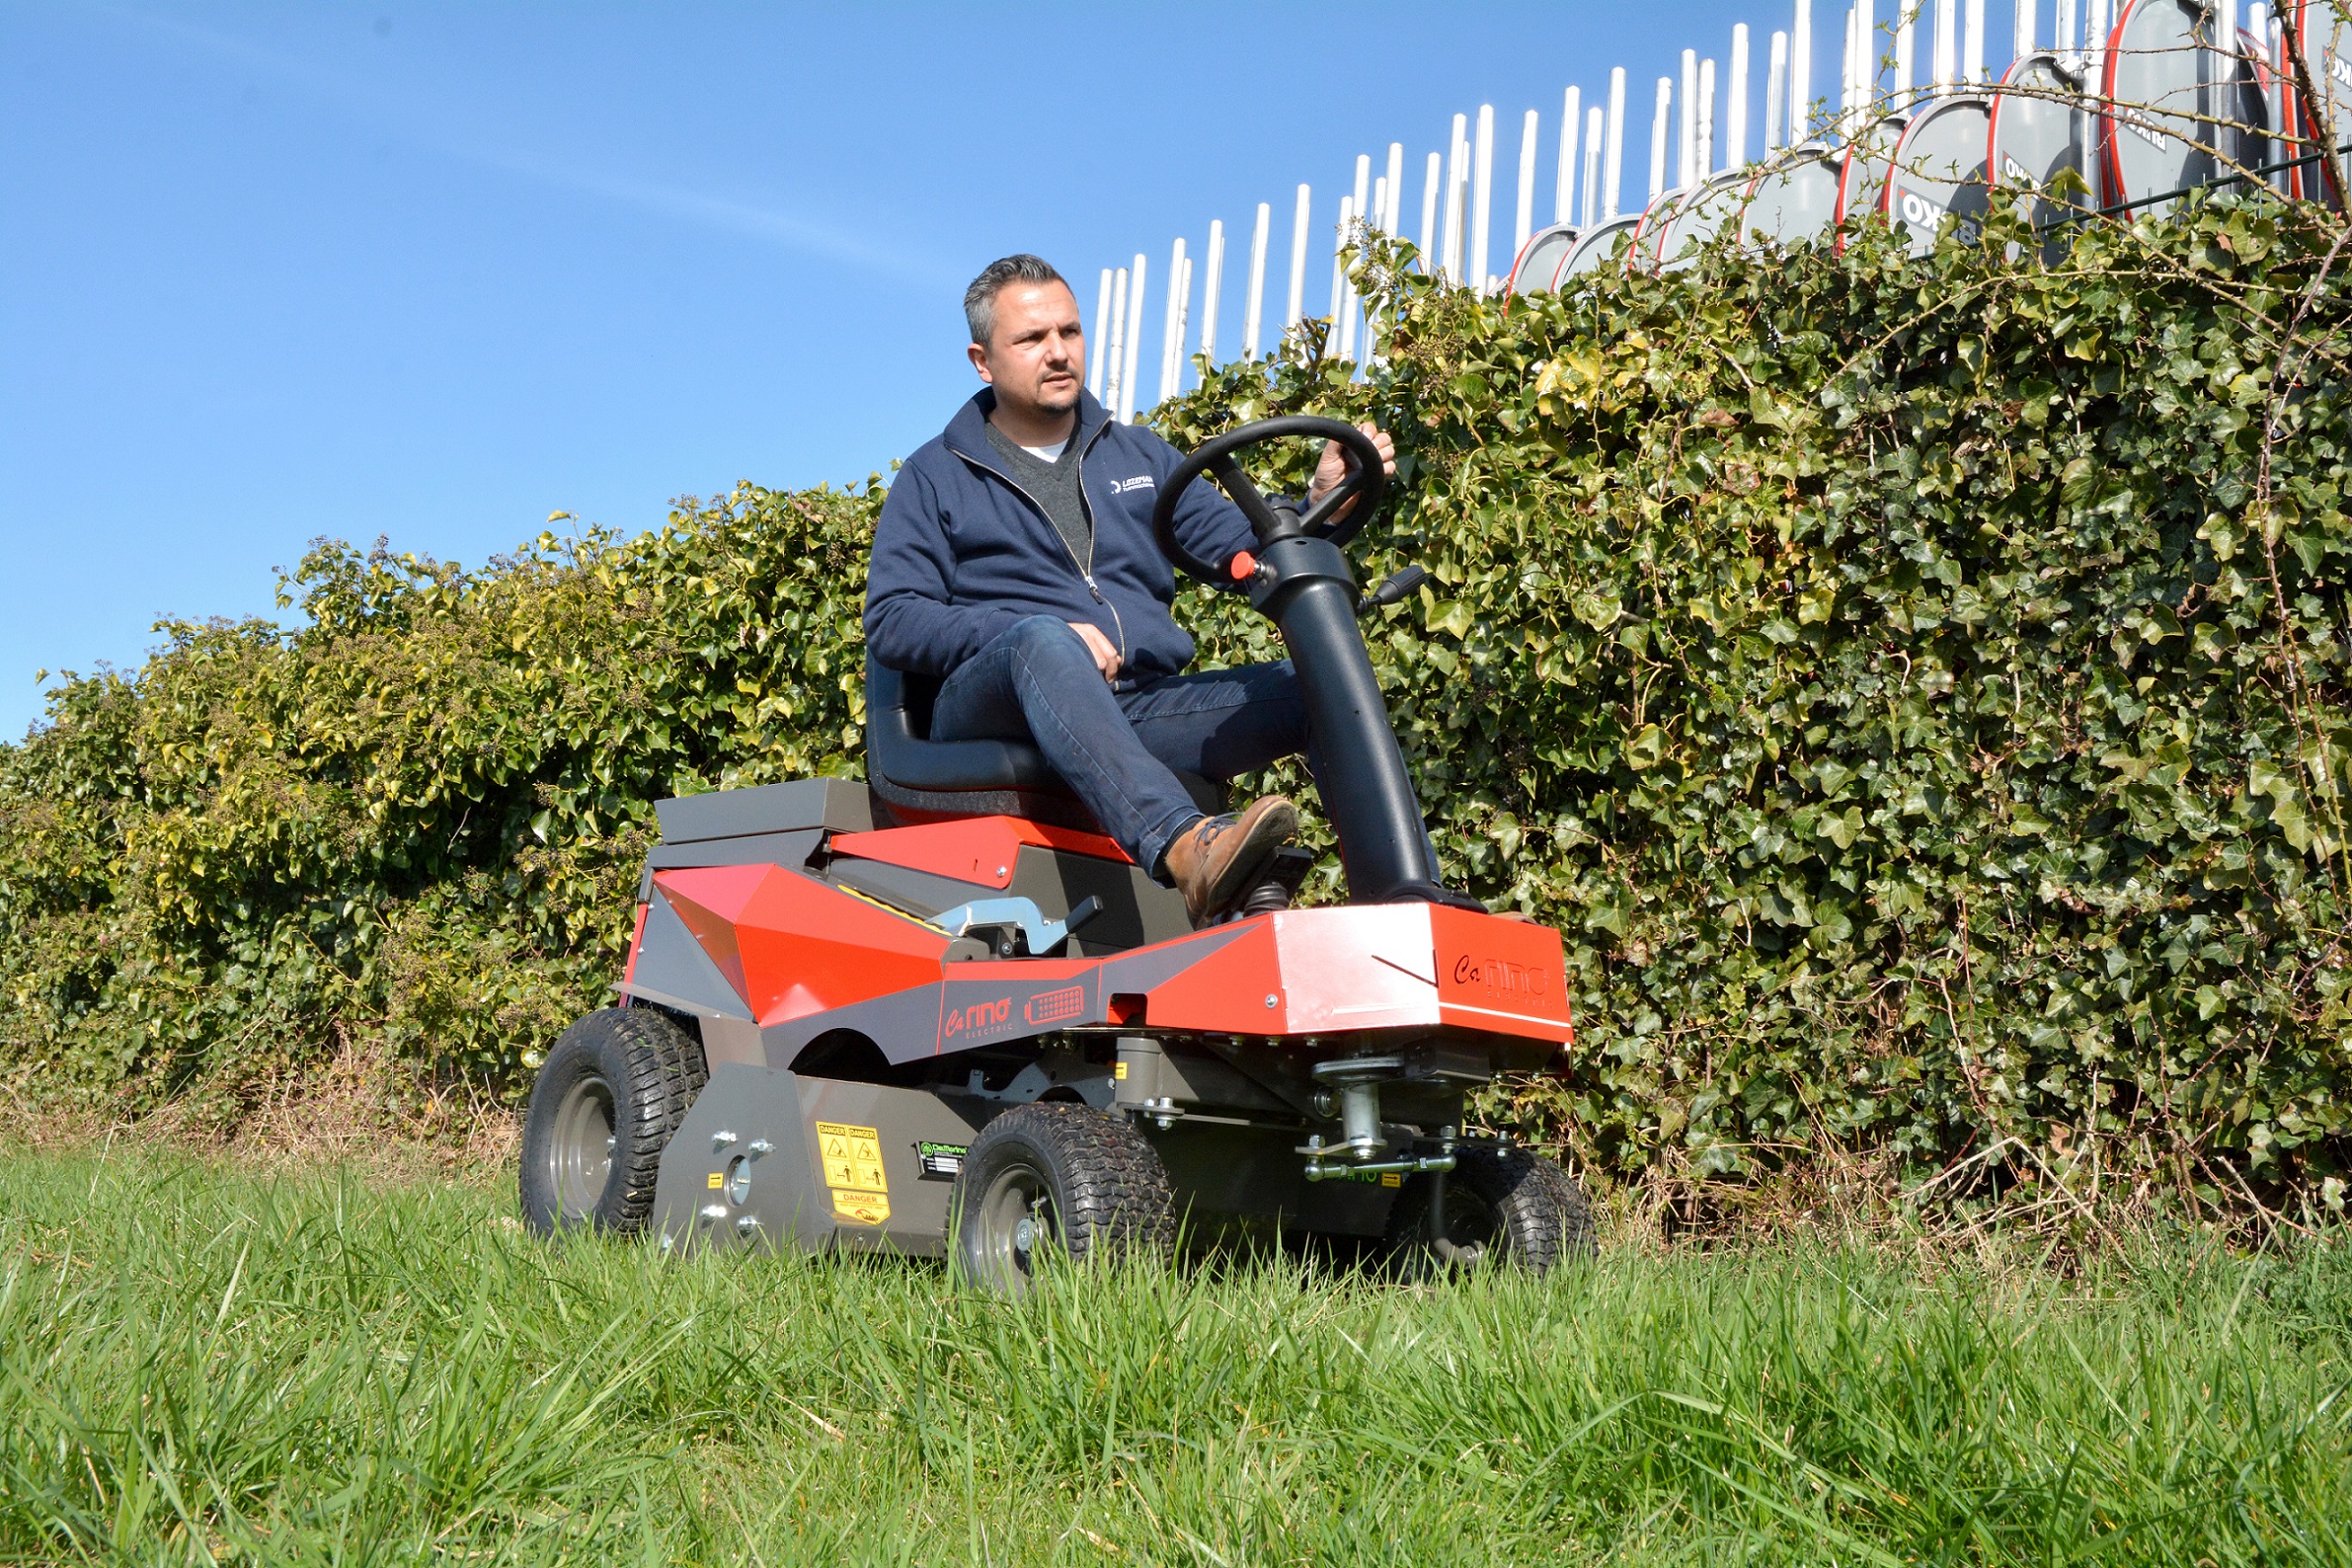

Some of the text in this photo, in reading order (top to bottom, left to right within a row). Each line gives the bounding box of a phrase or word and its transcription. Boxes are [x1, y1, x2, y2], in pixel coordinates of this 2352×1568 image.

[966, 1024, 1013, 1039] ELECTRIC
[820, 1125, 875, 1139] DANGER DANGER
[843, 1194, 878, 1204] DANGER
